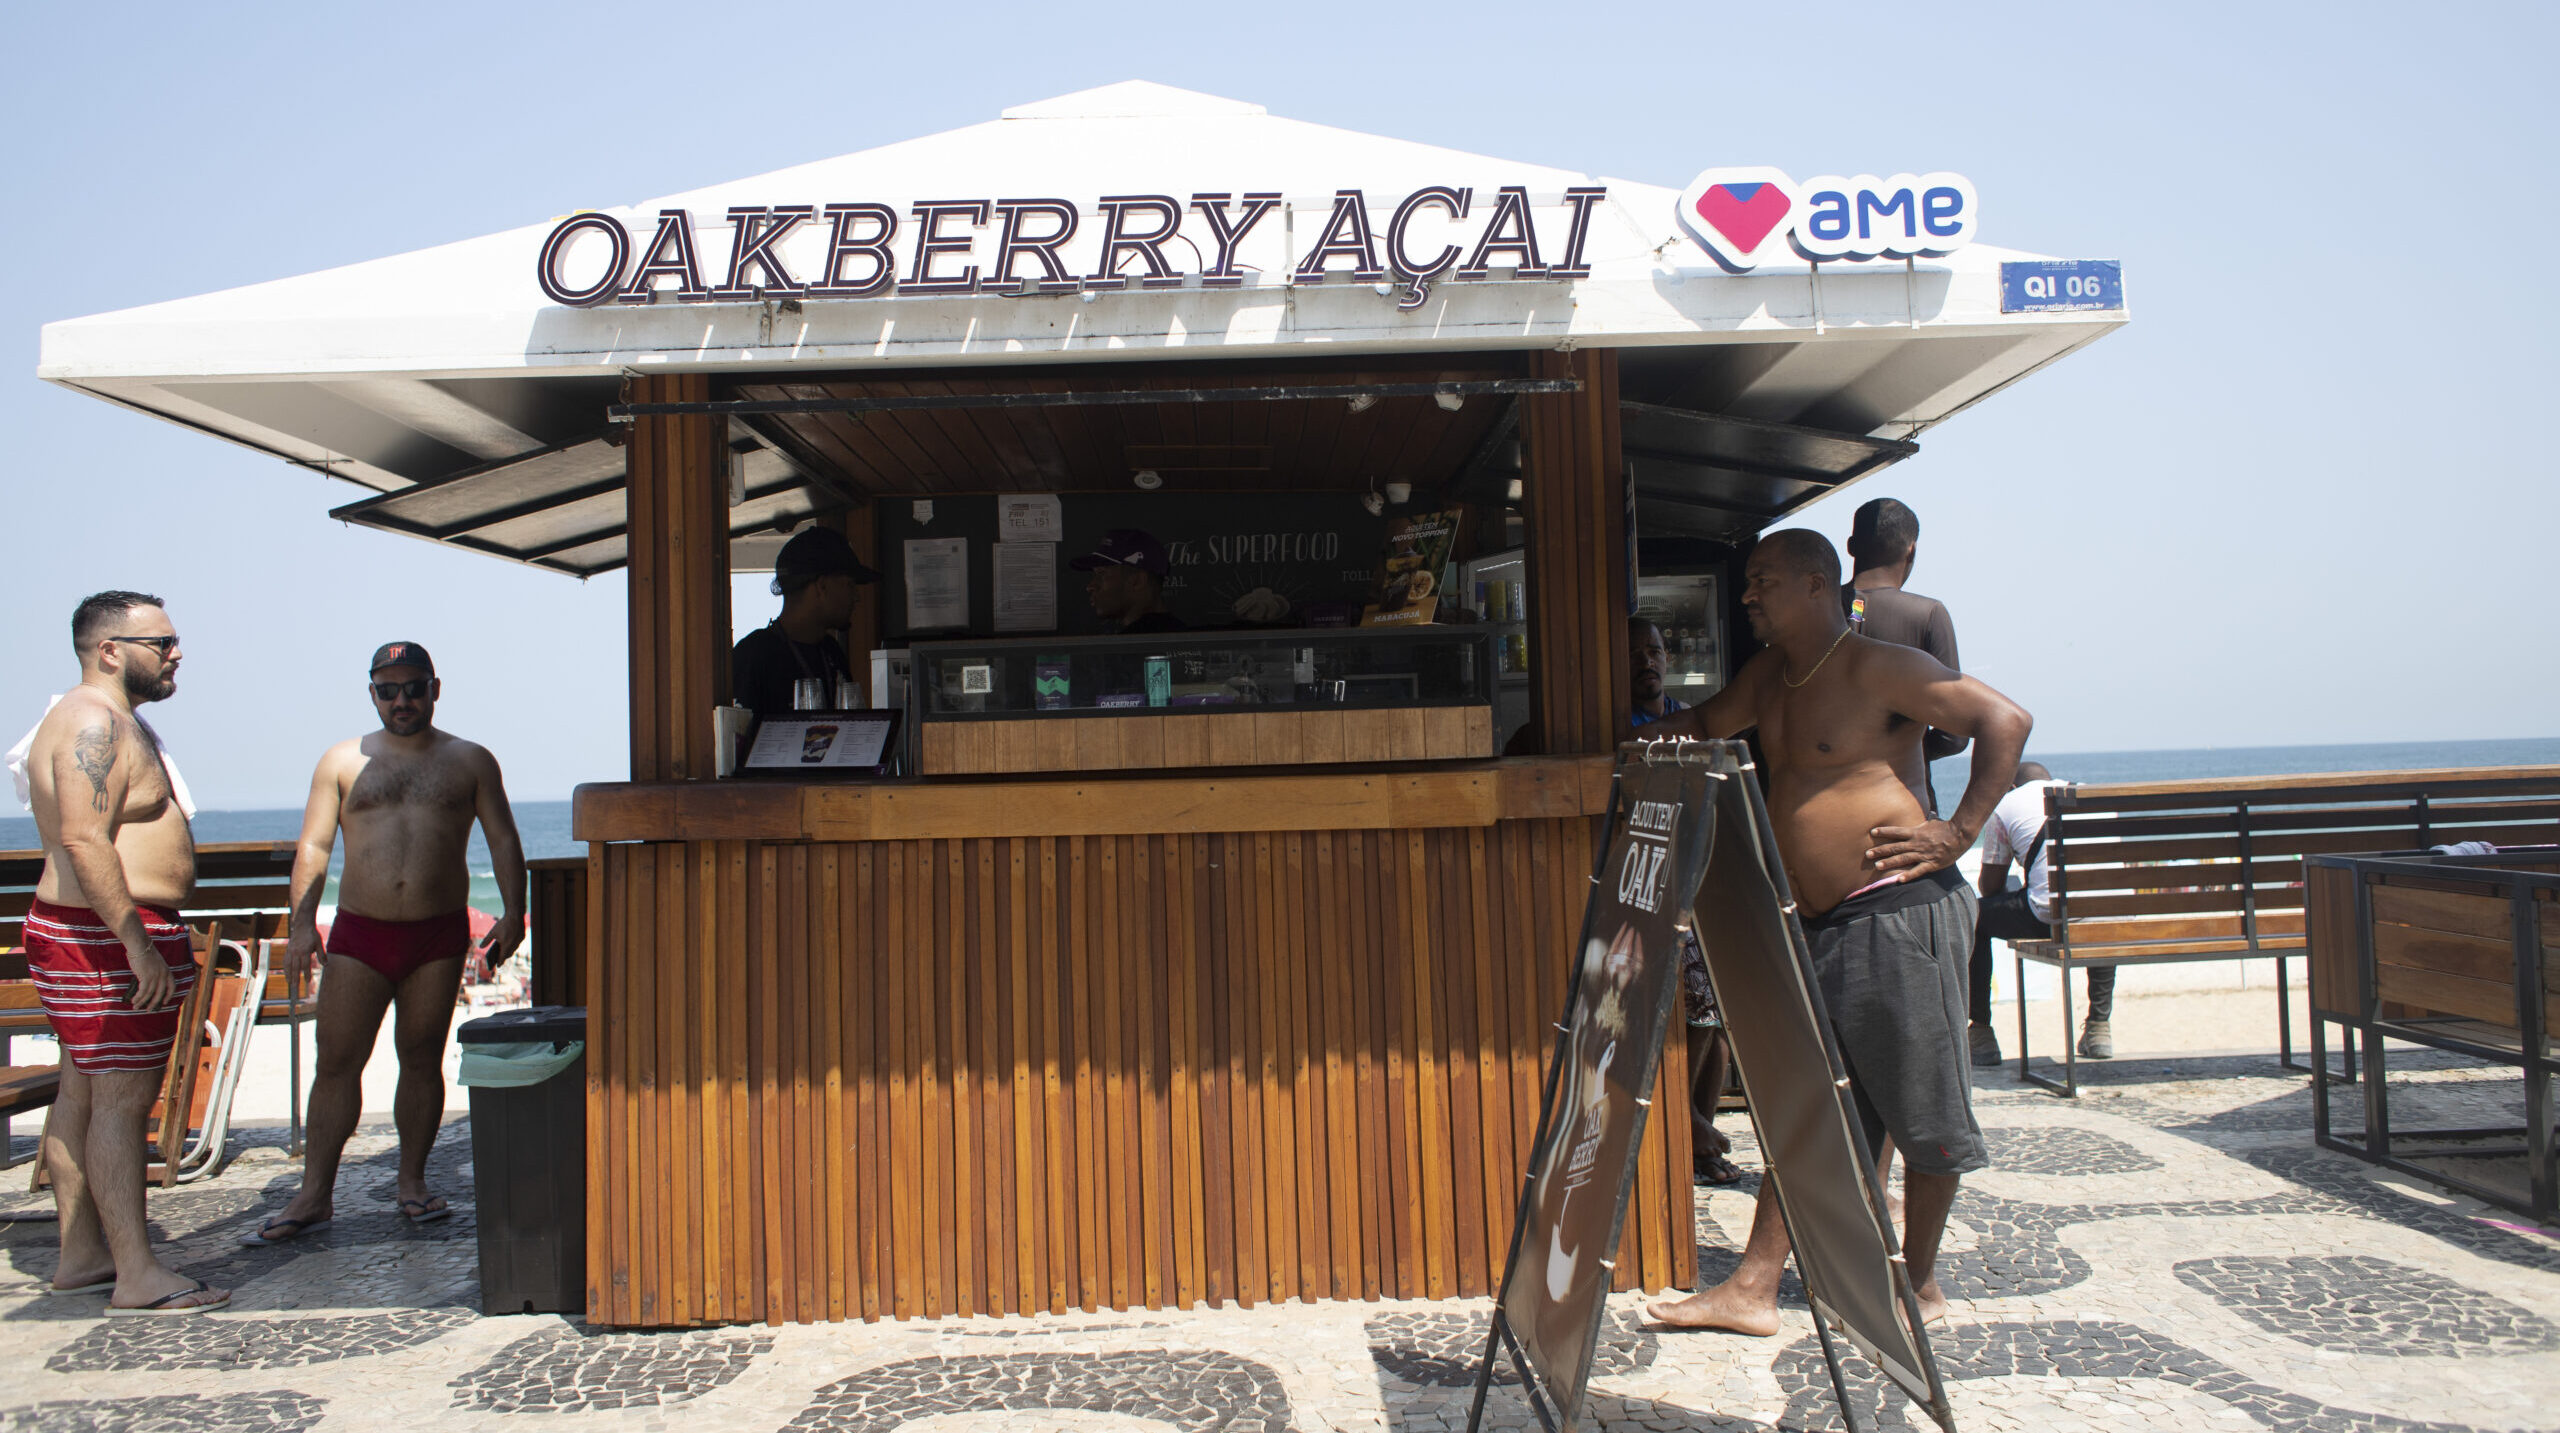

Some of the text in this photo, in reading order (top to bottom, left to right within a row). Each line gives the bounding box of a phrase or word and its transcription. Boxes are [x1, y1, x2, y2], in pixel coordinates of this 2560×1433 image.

[1808, 185, 1964, 241] ame
[537, 186, 1607, 311] OAKBERRY AÇAI
[2024, 276, 2102, 299] QI 06
[1008, 518, 1050, 528] TEL 151
[1391, 532, 1417, 543] NOVO
[1165, 532, 1339, 567] The SUPERFOOD
[1100, 700, 1140, 708] OAKBERRY
[1568, 1134, 1602, 1172] BERRY
